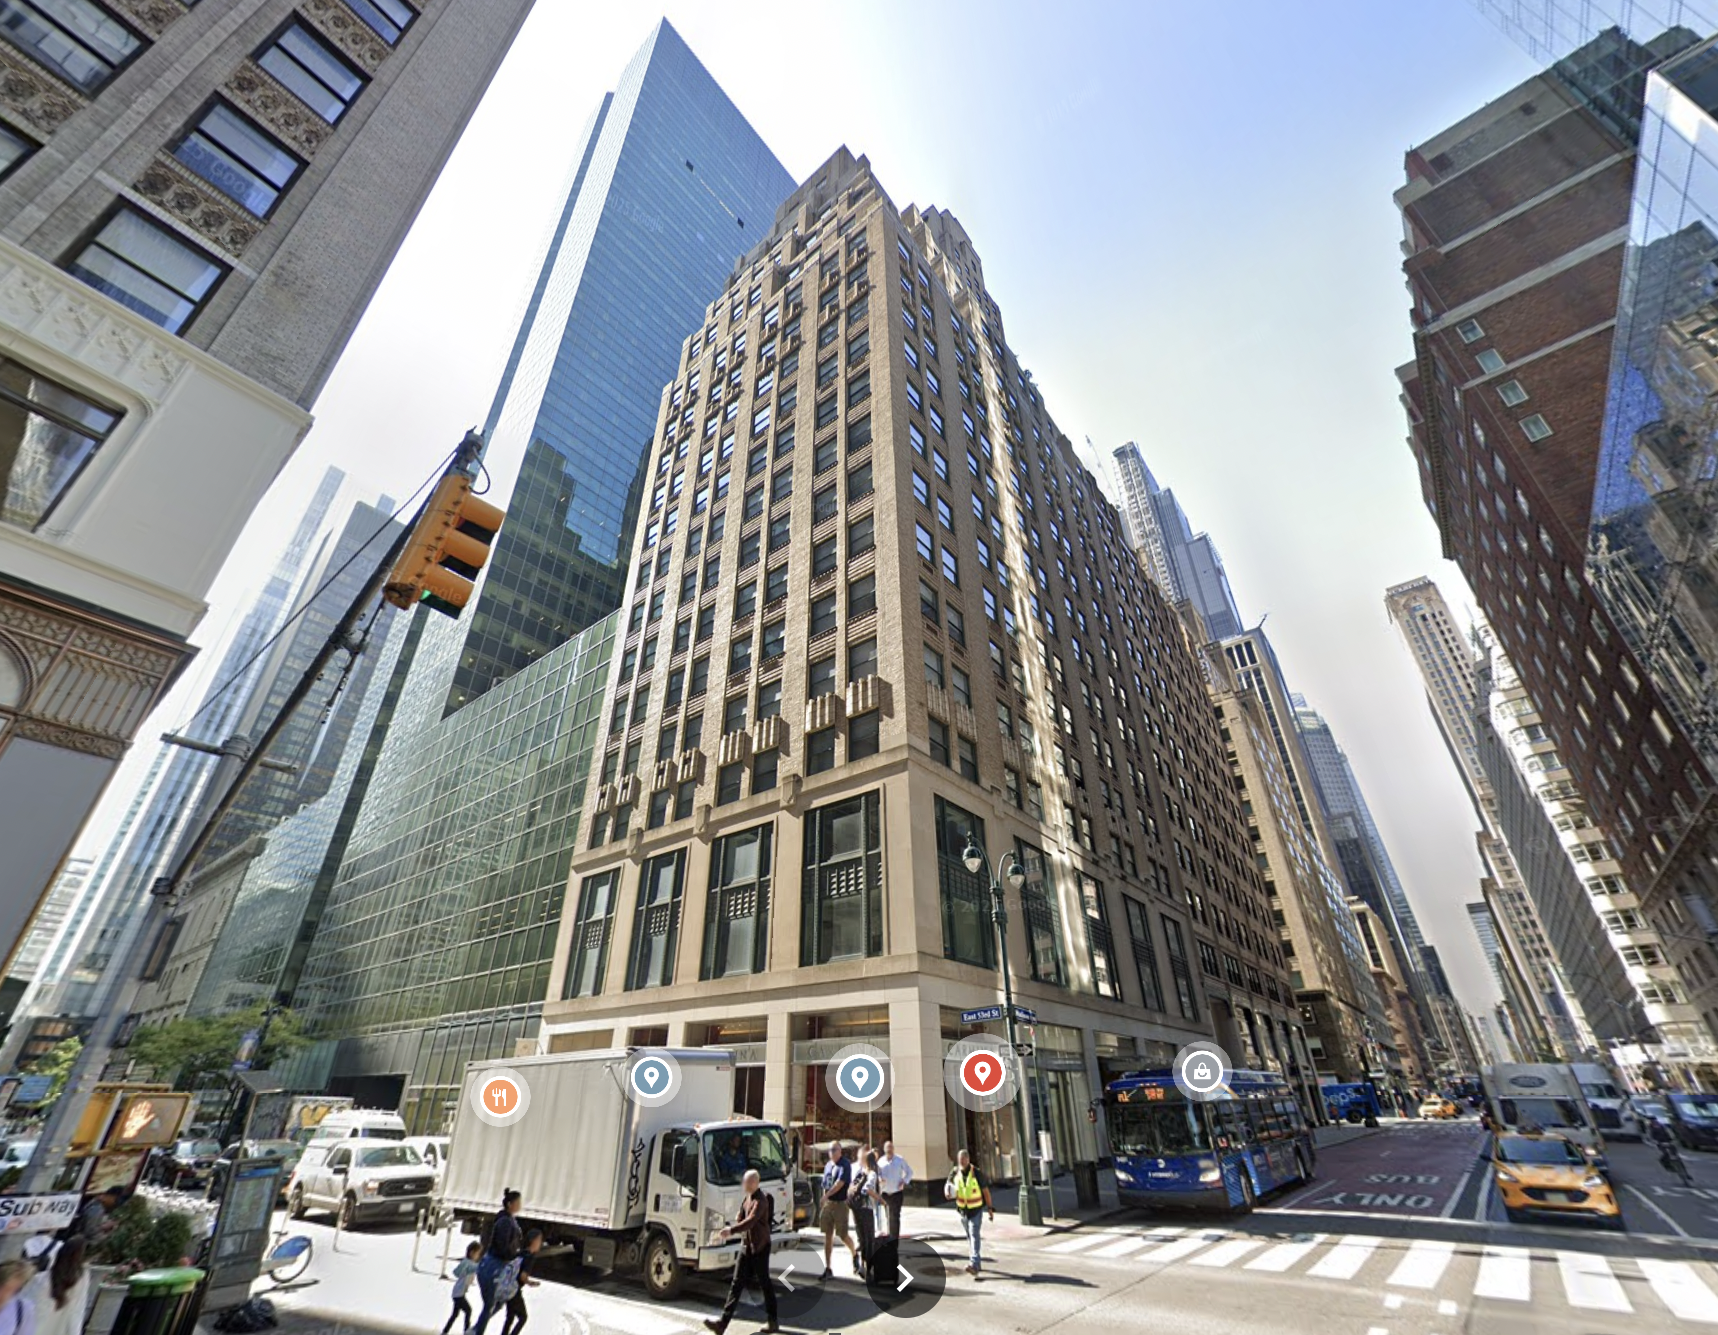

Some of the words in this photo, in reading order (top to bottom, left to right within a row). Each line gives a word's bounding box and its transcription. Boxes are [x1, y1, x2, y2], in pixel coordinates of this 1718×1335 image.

[1365, 1174, 1440, 1185] BUS
[0, 1199, 77, 1217] Subway
[1313, 1192, 1434, 1208] ONLY
